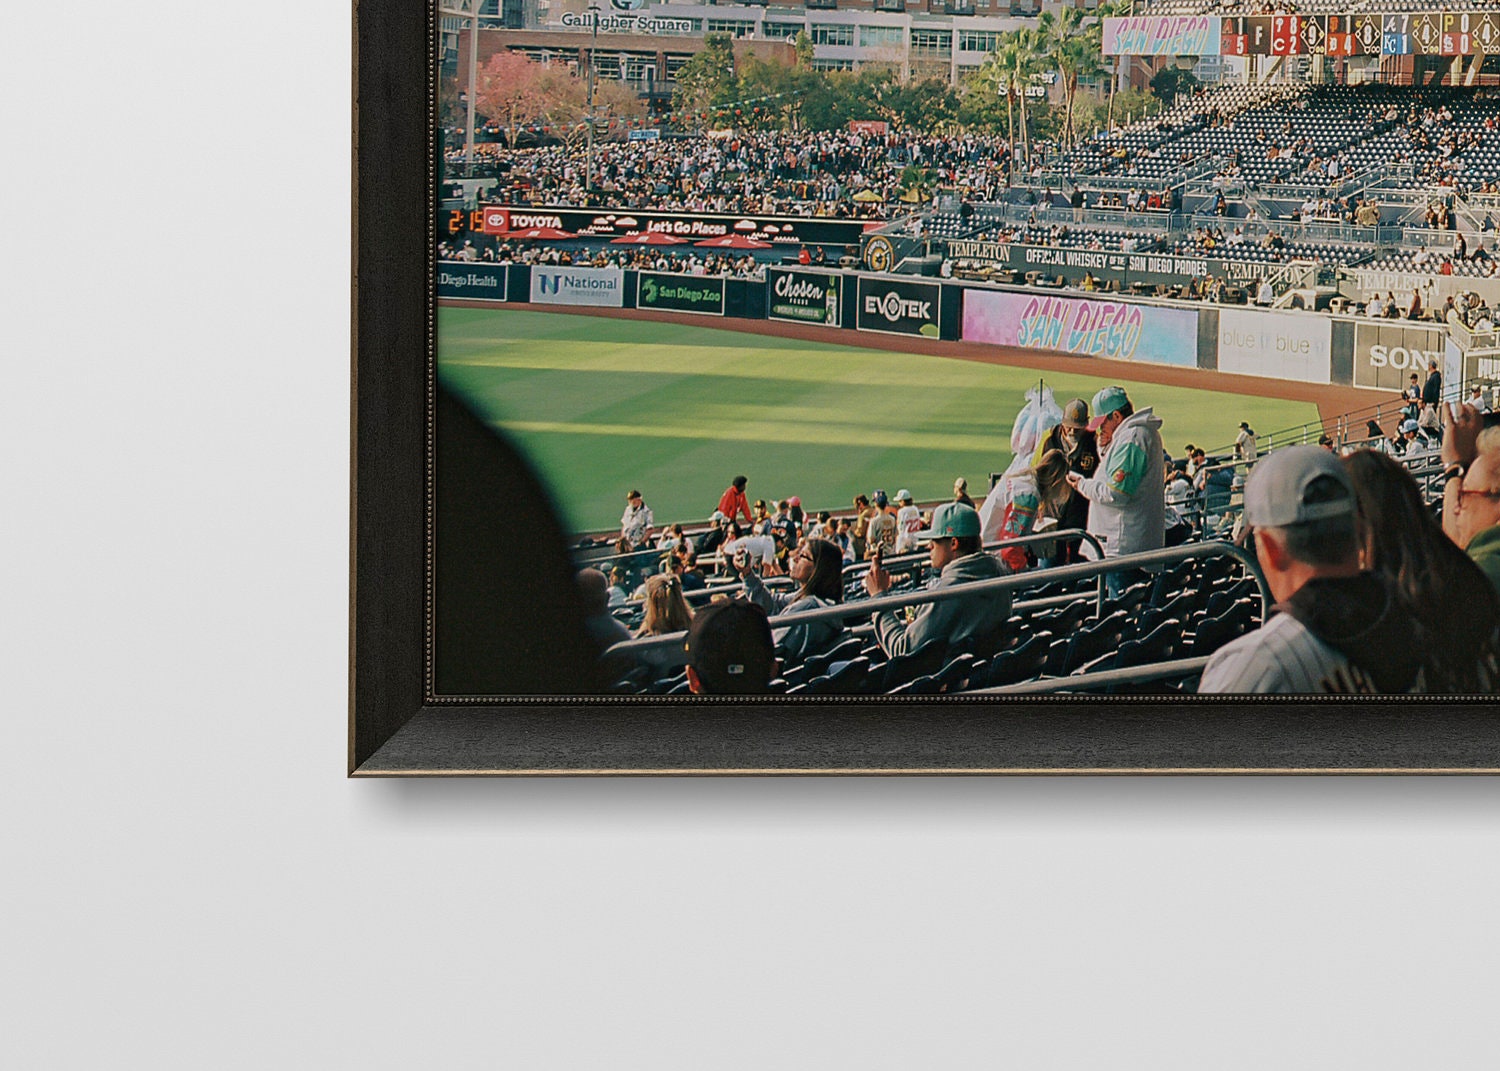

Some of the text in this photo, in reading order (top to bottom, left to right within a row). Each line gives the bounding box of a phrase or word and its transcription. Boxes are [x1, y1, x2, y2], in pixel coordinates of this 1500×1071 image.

[637, 16, 690, 31] Square
[1289, 17, 1297, 35] 8
[1401, 15, 1409, 32] 7
[1444, 15, 1469, 33] P 0
[1112, 17, 1210, 55] SAN DIEGO
[1255, 26, 1263, 46] F
[1307, 25, 1316, 45] 9
[1363, 25, 1372, 44] 8
[1423, 24, 1430, 44] 4
[1481, 24, 1490, 43] 4
[1236, 36, 1244, 54] 5
[1289, 36, 1297, 55] 2
[1343, 35, 1352, 53] 4
[1460, 35, 1469, 53] 0
[448, 209, 485, 233] 2:15
[510, 214, 563, 229] TOYOTA
[647, 220, 728, 236] Let's Go Places
[947, 241, 1011, 263] TEMPLETON
[1066, 250, 1108, 269] WHISKEY
[1128, 255, 1147, 272] SAN
[1147, 257, 1174, 274] DIEGO
[1174, 259, 1208, 276] PADRES
[440, 272, 498, 288] Diego Health
[564, 275, 618, 290] National
[774, 273, 824, 300] Chosen
[659, 285, 721, 303] San Diego Zoo
[865, 291, 931, 322] EVOTEK
[1018, 294, 1143, 360] SAN DIEGO
[1222, 328, 1310, 355] blue blue
